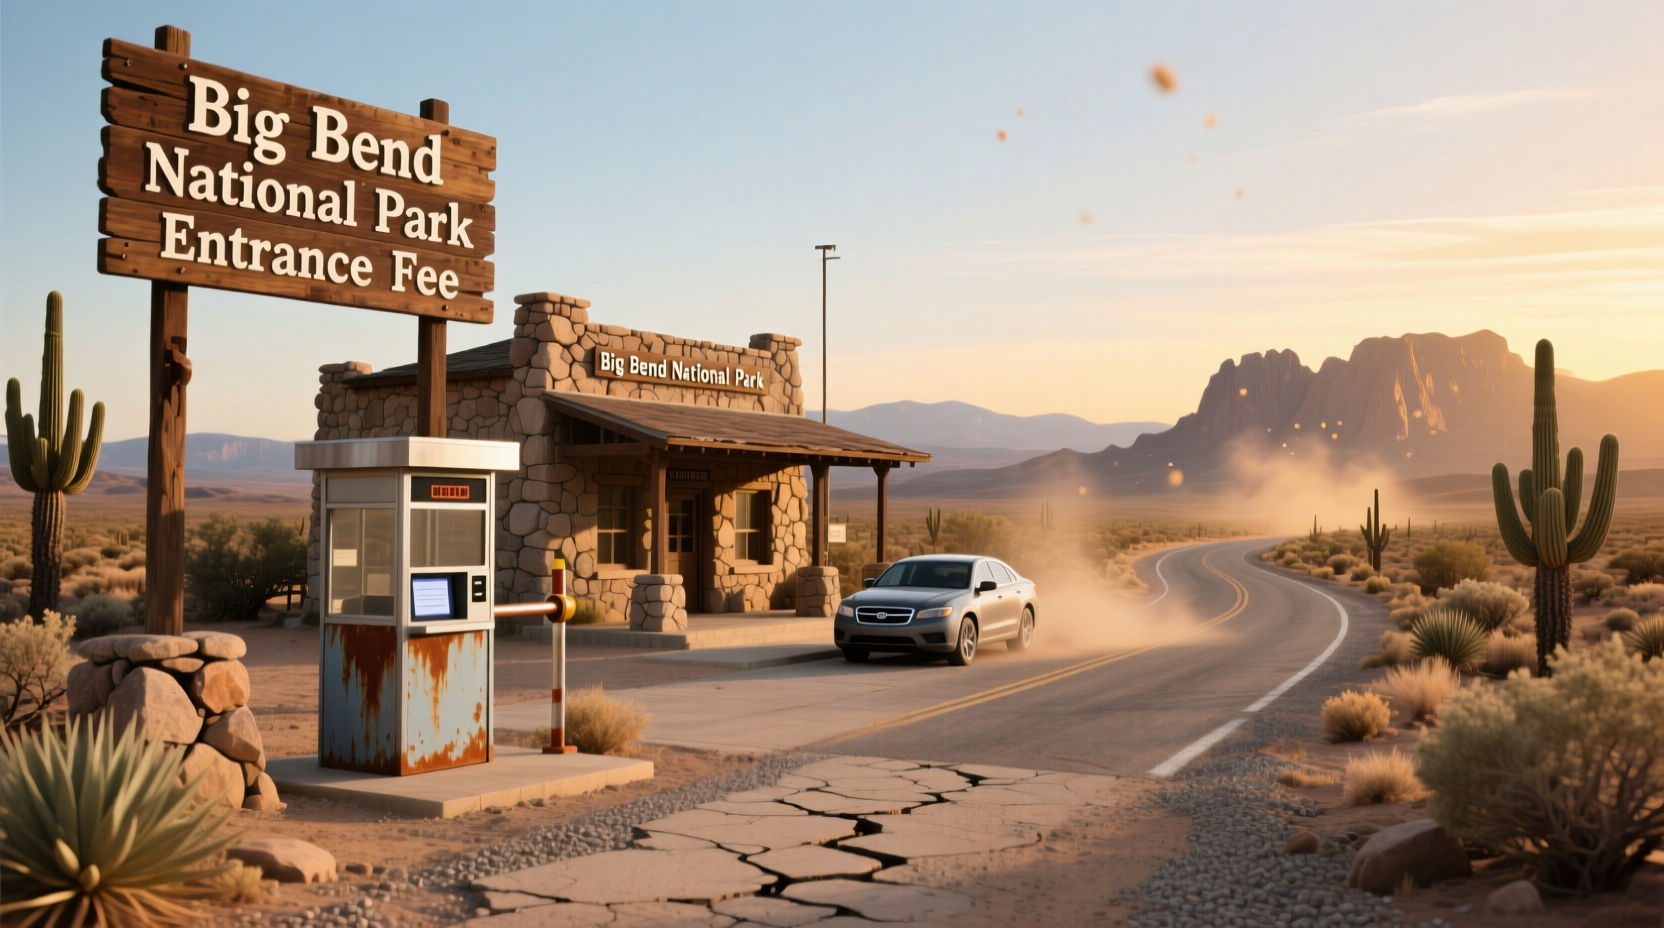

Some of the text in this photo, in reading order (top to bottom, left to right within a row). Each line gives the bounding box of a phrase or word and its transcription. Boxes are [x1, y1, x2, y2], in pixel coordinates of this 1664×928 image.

[188, 75, 444, 185] Big Bend
[145, 141, 474, 249] National Park
[160, 211, 459, 300] Entrance Fee
[601, 351, 764, 389] Big Bend National Park
